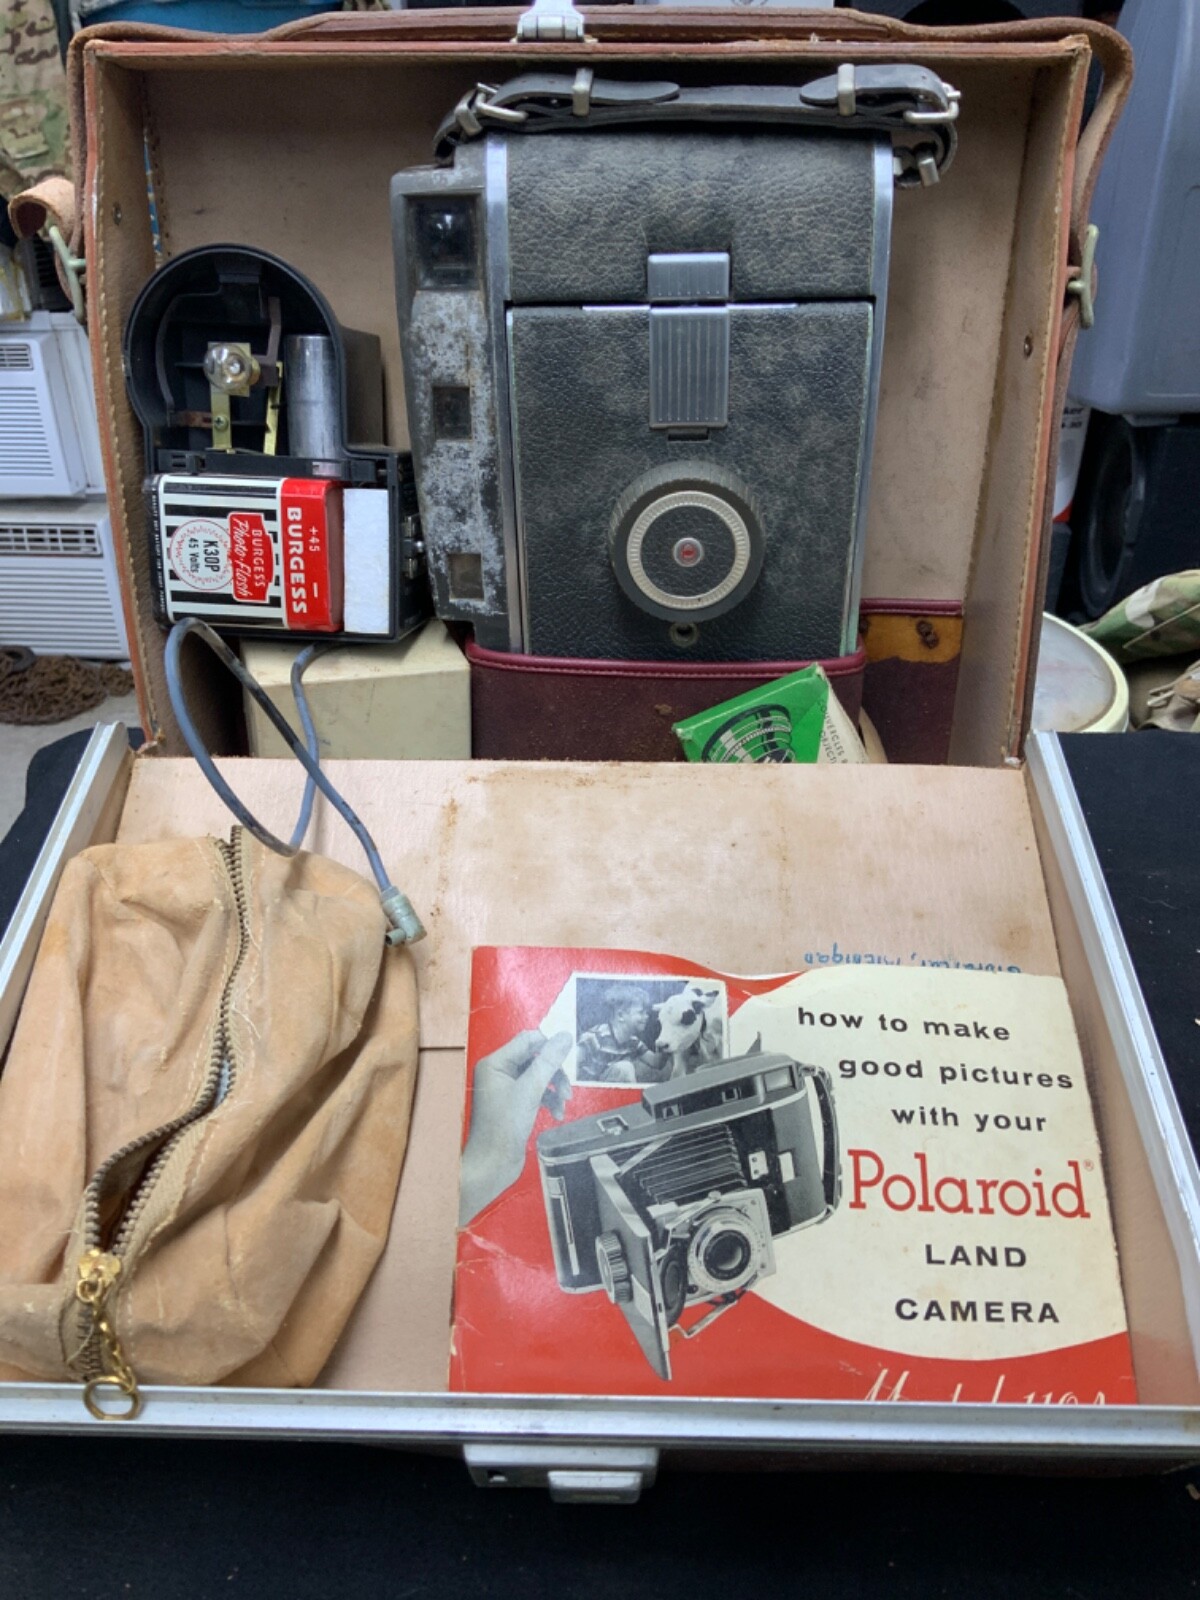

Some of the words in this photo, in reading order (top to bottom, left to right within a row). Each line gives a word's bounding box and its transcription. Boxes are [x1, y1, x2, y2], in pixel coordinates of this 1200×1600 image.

[188, 537, 198, 548] 45
[202, 540, 220, 573] K30P
[188, 551, 199, 573] Volts
[251, 529, 266, 587] BURGESS
[286, 507, 307, 614] BURGESS
[798, 1007, 863, 1028] how
[878, 1014, 908, 1032] to
[923, 1021, 1010, 1041] make
[839, 1059, 924, 1078] good
[940, 1063, 1073, 1089] pictures
[891, 1106, 960, 1127] with
[974, 1112, 1047, 1132] your
[925, 1244, 1027, 1267] LAND
[895, 1298, 1060, 1323] CAMERA
